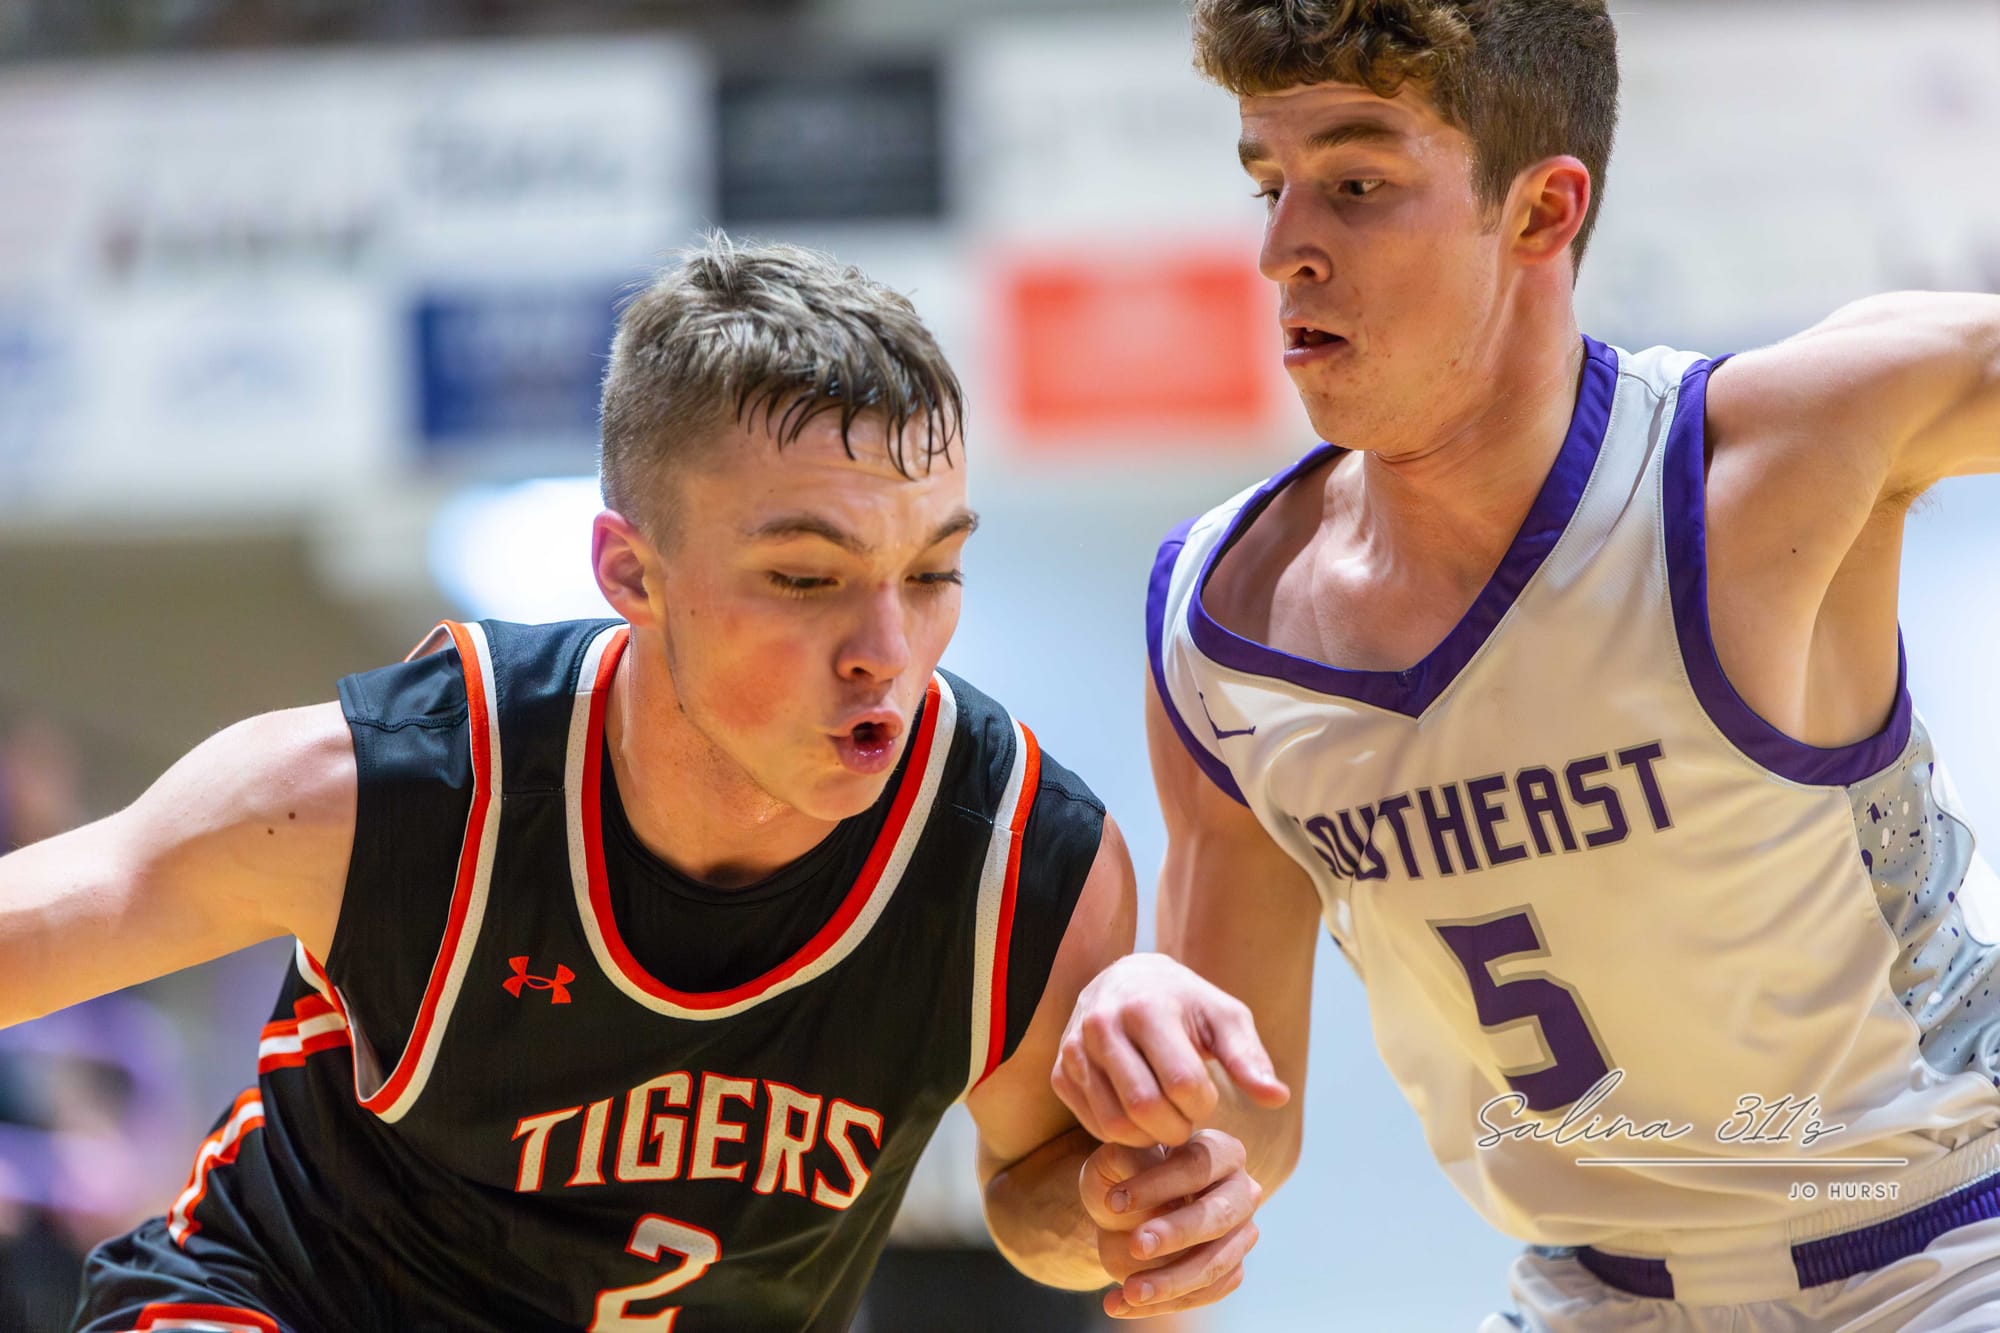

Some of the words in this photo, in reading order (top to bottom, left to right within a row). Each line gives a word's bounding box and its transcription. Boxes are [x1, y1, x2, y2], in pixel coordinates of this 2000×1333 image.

[1292, 739, 1675, 881] OUTHEAST
[1425, 903, 1617, 1120] 5
[511, 1071, 884, 1211] TIGERS
[587, 1213, 722, 1333] 2
